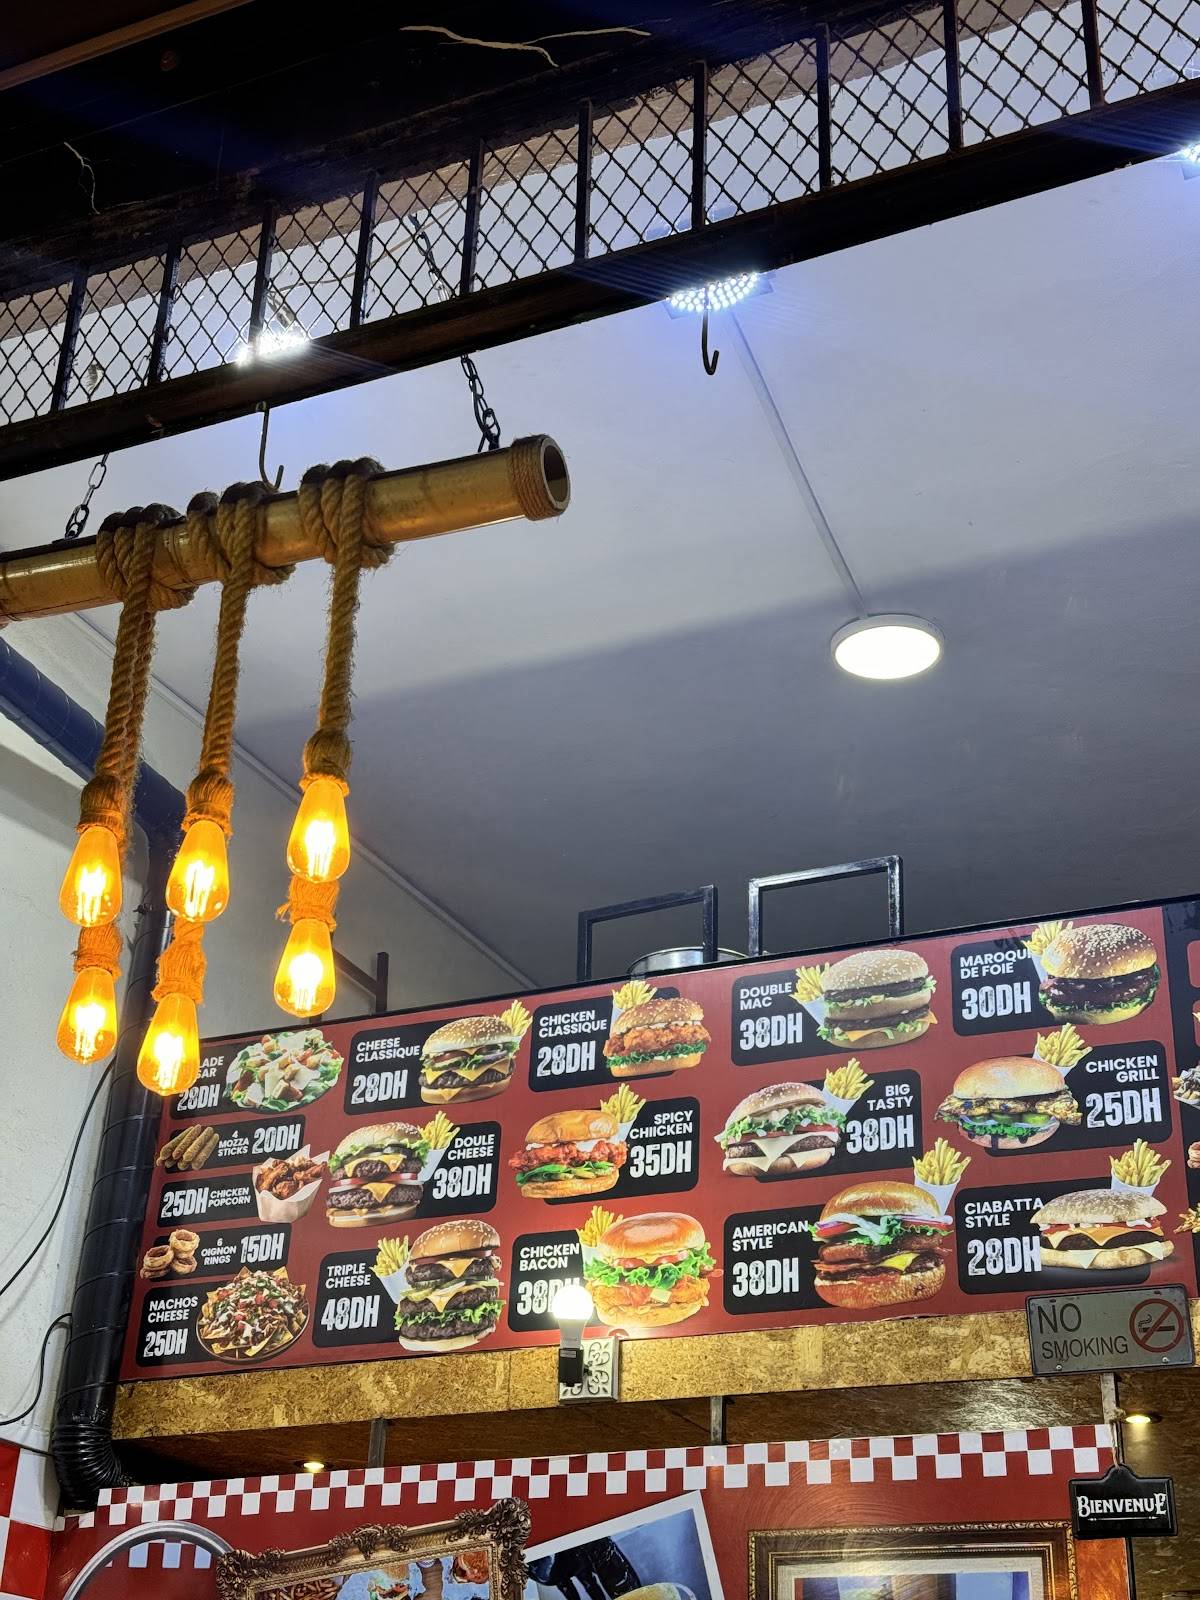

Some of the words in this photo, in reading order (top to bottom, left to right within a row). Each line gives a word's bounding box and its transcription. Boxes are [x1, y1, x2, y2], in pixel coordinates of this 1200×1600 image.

[960, 967, 979, 979] DE
[982, 962, 1014, 976] FOIE
[740, 982, 792, 999] DOUBLE
[740, 997, 772, 1011] MAC
[961, 981, 1031, 1020] 30DH
[539, 1009, 596, 1027] CHICKEN
[539, 1019, 607, 1038] CLASSIQUE
[739, 1012, 803, 1050] 38DH
[357, 1037, 401, 1052] CHEESE
[355, 1045, 420, 1063] CLASSIQUE
[536, 1040, 596, 1077] 28DH
[1085, 1054, 1158, 1074] CHICKEN
[1116, 1068, 1160, 1083] GRILL
[351, 1069, 408, 1105] 28DH
[885, 1083, 910, 1097] BIG
[177, 1084, 220, 1111] 28DH
[867, 1096, 913, 1111] TASTY
[1086, 1087, 1162, 1129] 25DH
[653, 1109, 694, 1126] SPICY
[232, 1130, 239, 1138] 4
[252, 1124, 301, 1155] 20DH
[454, 1133, 495, 1149] DOULE
[846, 1114, 914, 1154] 38DH
[218, 1138, 249, 1148] MOZZA
[218, 1146, 249, 1157] STICKS
[447, 1145, 494, 1161] CHEESE
[629, 1140, 692, 1179] 35DH
[432, 1163, 493, 1200] 38DH
[208, 1195, 251, 1208] POPCORN
[210, 1187, 249, 1199] CHICKEN
[161, 1187, 209, 1218] 25DH
[964, 1197, 1045, 1215] CIABATTA
[965, 1213, 1011, 1228] STYLE
[732, 1220, 808, 1239] AMERICAN
[217, 1238, 223, 1246] 6
[240, 1232, 285, 1264] 15DH
[520, 1243, 580, 1258] CHICKEN
[732, 1236, 773, 1252] STYLE
[201, 1245, 236, 1257] OIGNON
[204, 1254, 231, 1265] RINGS
[967, 1235, 1042, 1276] 28DH
[326, 1263, 366, 1277] TRIPLE
[519, 1256, 568, 1271] BACON
[325, 1274, 371, 1289] CHEESE
[732, 1257, 799, 1297] 38DH
[150, 1296, 199, 1311] NACHOS
[147, 1308, 189, 1323] CHEESE
[320, 1294, 380, 1331] 48DH
[1037, 1303, 1082, 1334] NO
[143, 1328, 188, 1357] 25DH
[1042, 1335, 1128, 1360] SMOKING
